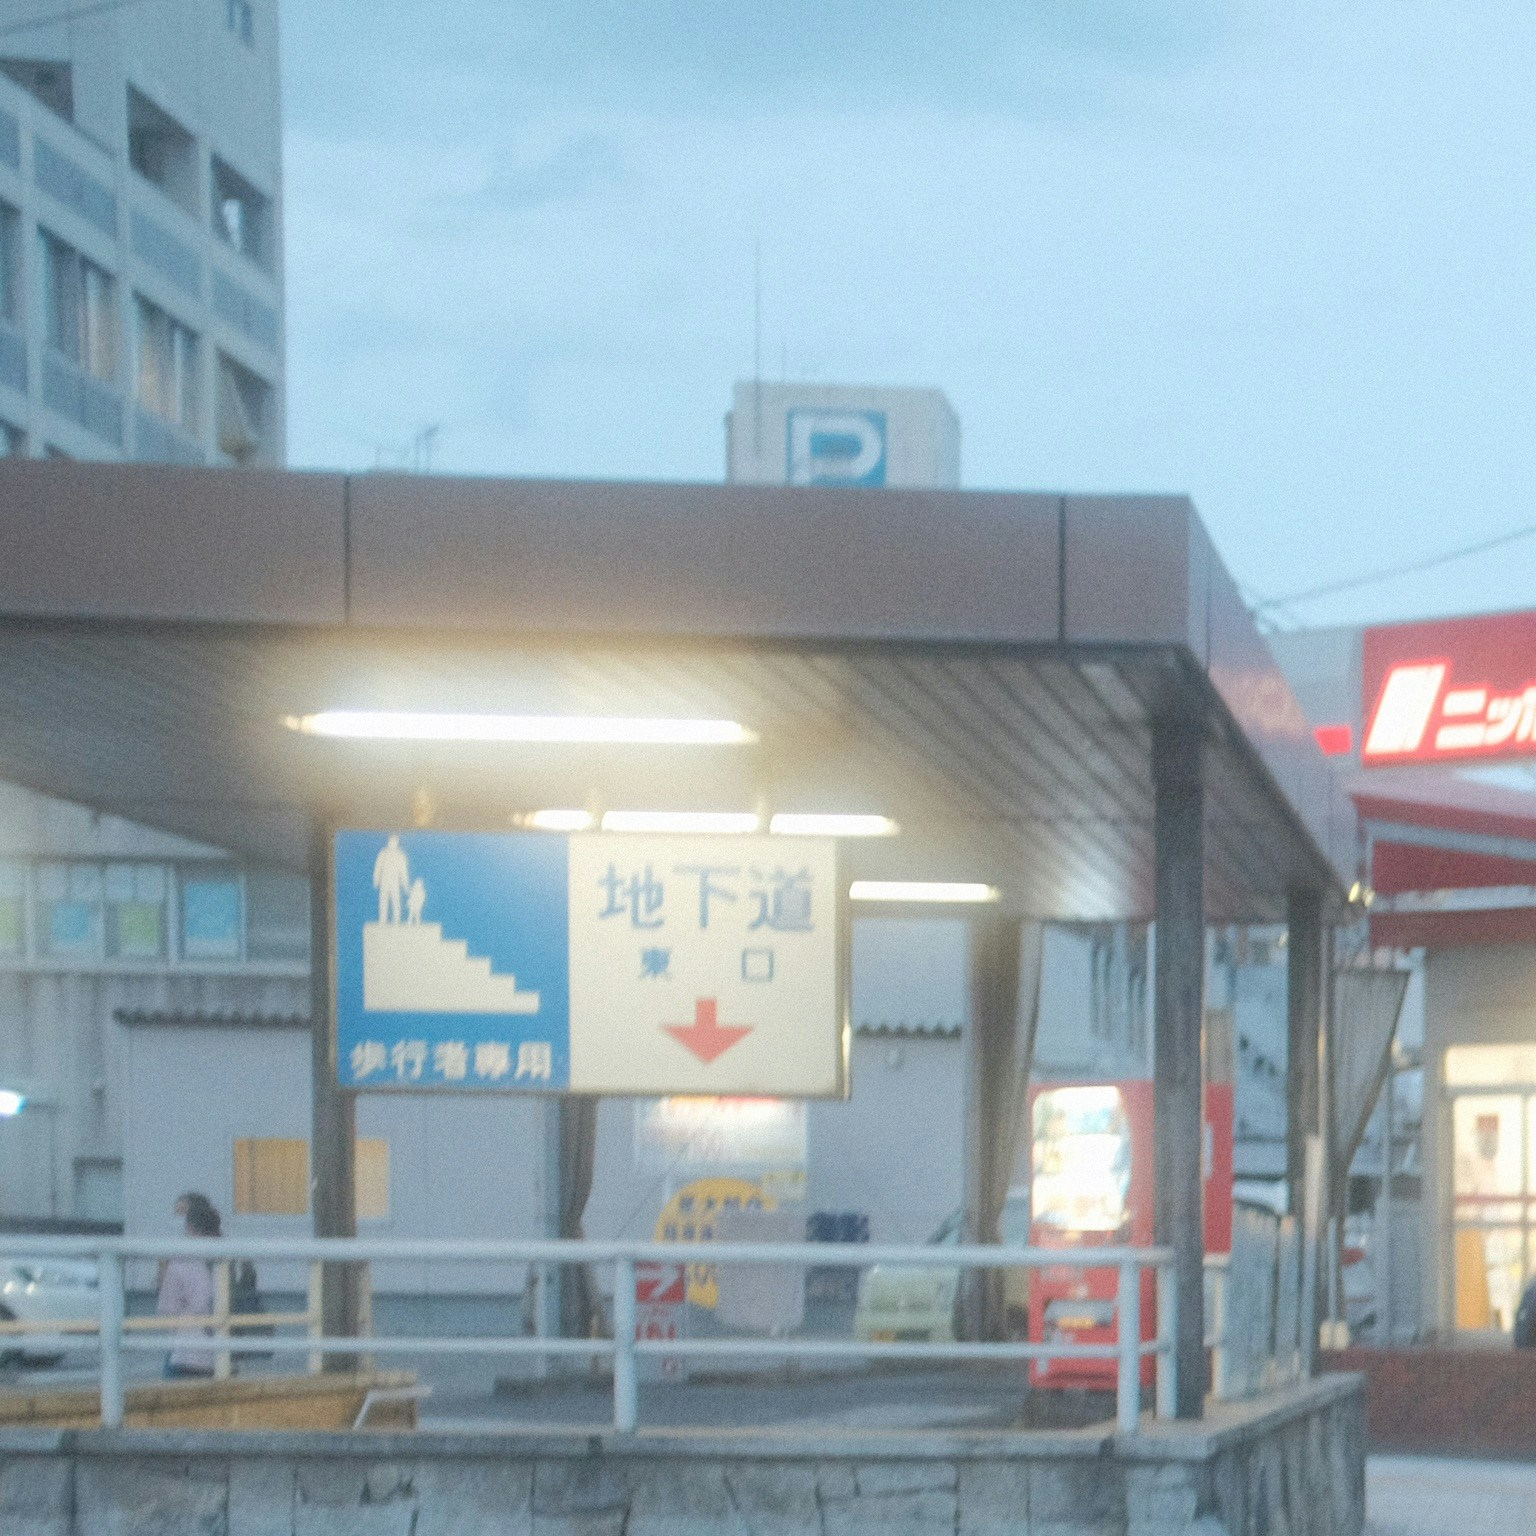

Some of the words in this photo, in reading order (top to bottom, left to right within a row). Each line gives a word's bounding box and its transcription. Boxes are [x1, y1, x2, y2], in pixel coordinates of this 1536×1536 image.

[792, 412, 883, 485] P
[597, 864, 816, 933] 地下道
[637, 945, 776, 983] 東口
[350, 1040, 554, 1082] 歩行者専用
